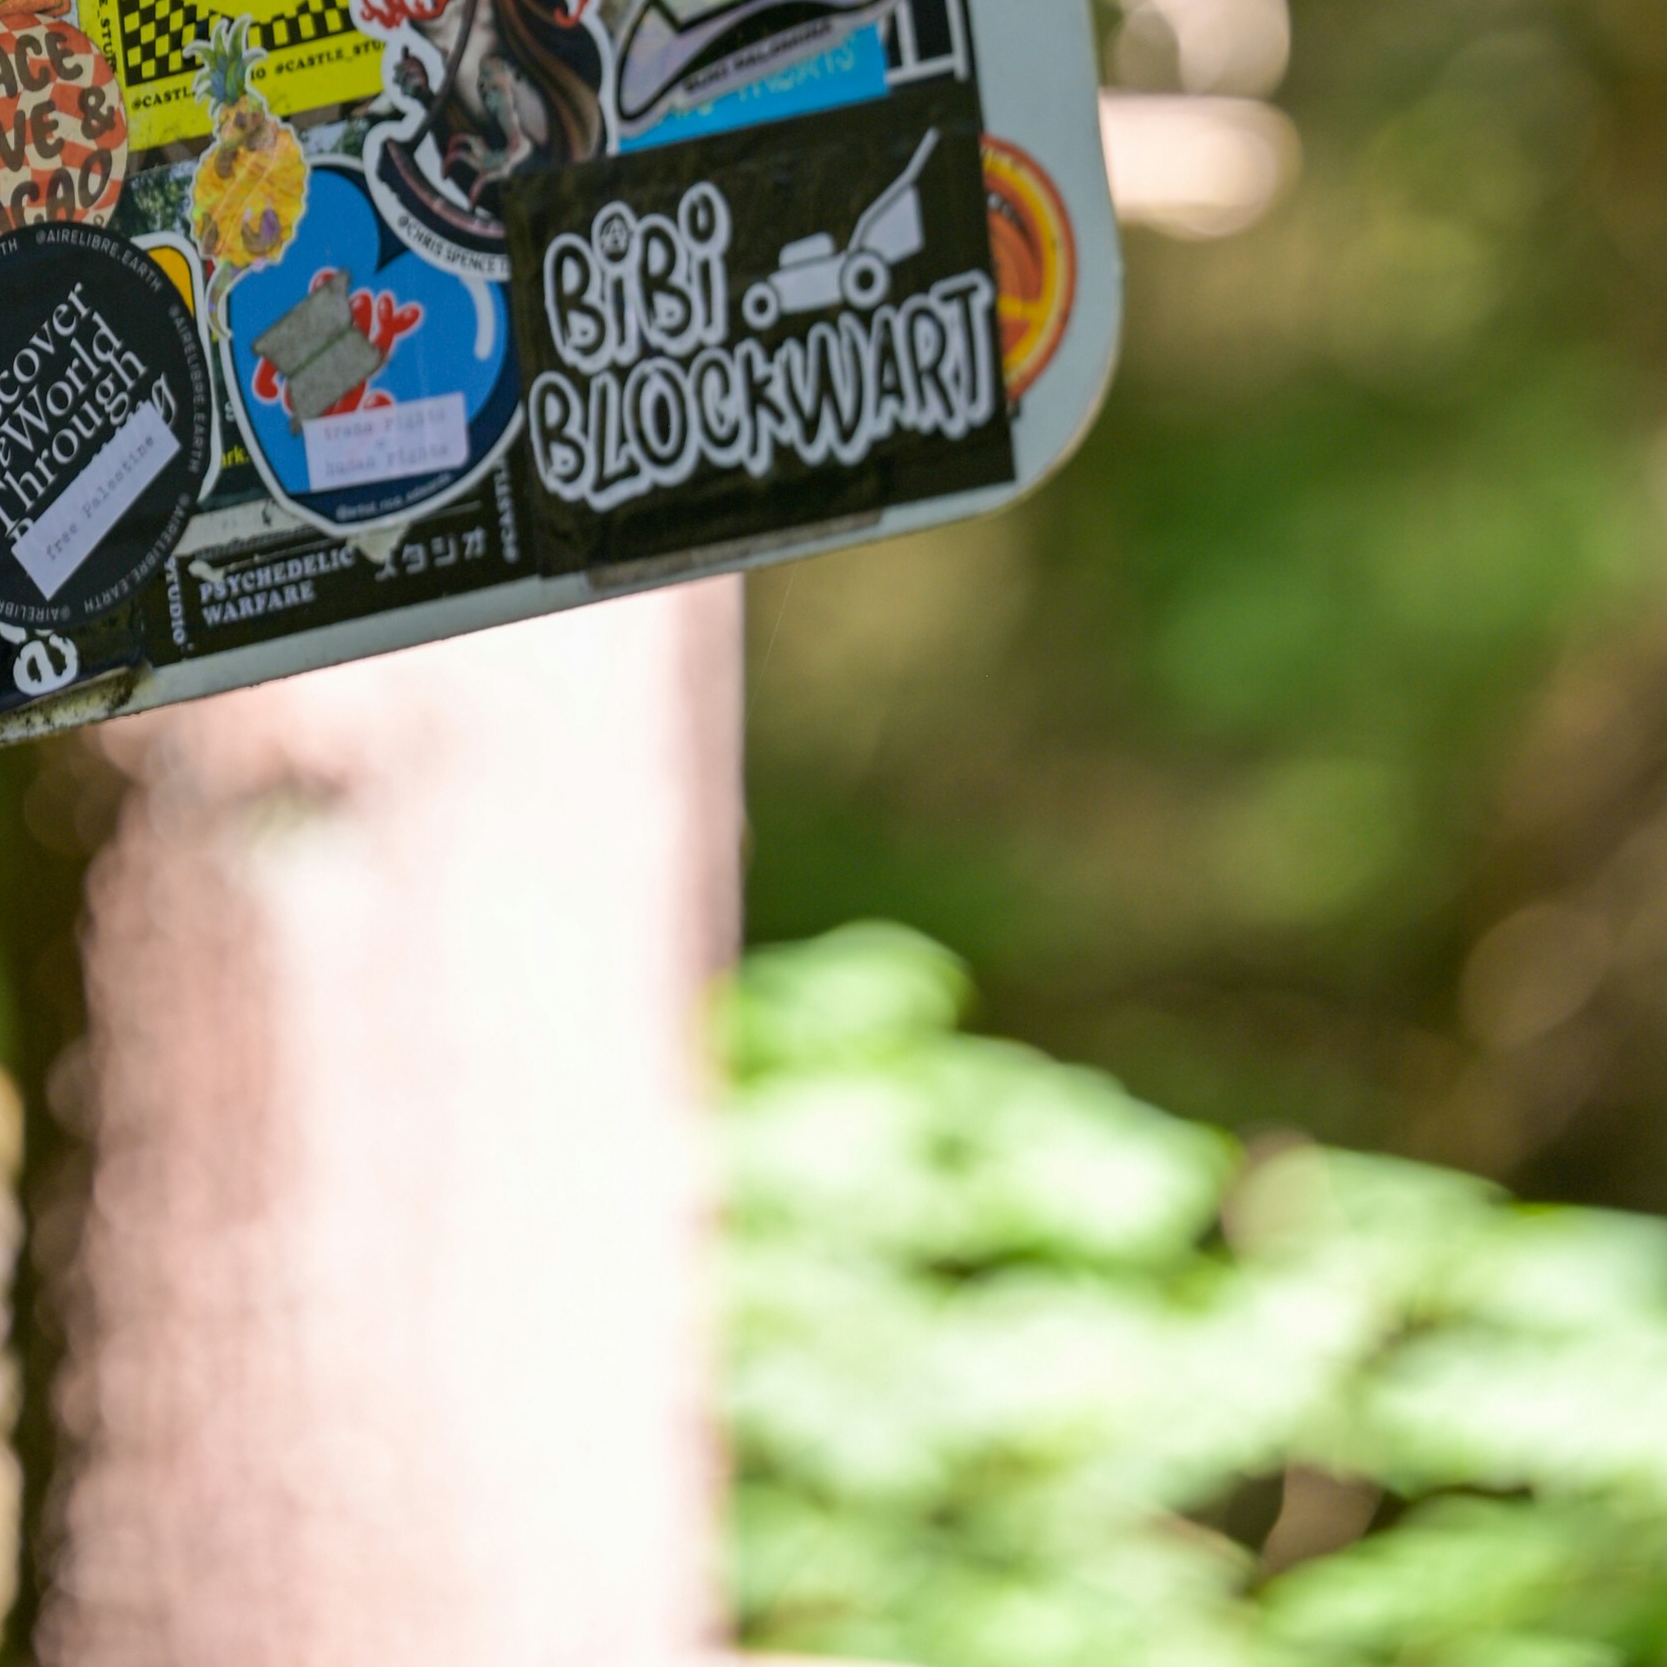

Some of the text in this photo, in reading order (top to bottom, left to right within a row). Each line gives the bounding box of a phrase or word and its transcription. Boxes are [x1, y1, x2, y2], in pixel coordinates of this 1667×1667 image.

[81, 85, 115, 139] &
[35, 228, 163, 293] @AIRELIBRE.EARTH
[6, 312, 125, 455] World
[168, 303, 210, 474] @AIRELIBRE.EARTH
[45, 433, 156, 562] free Palestine
[84, 492, 191, 613] @AIRELIBRE.EARTH
[200, 544, 356, 604] PSYCHEDELIC
[202, 583, 316, 629] WARFARE
